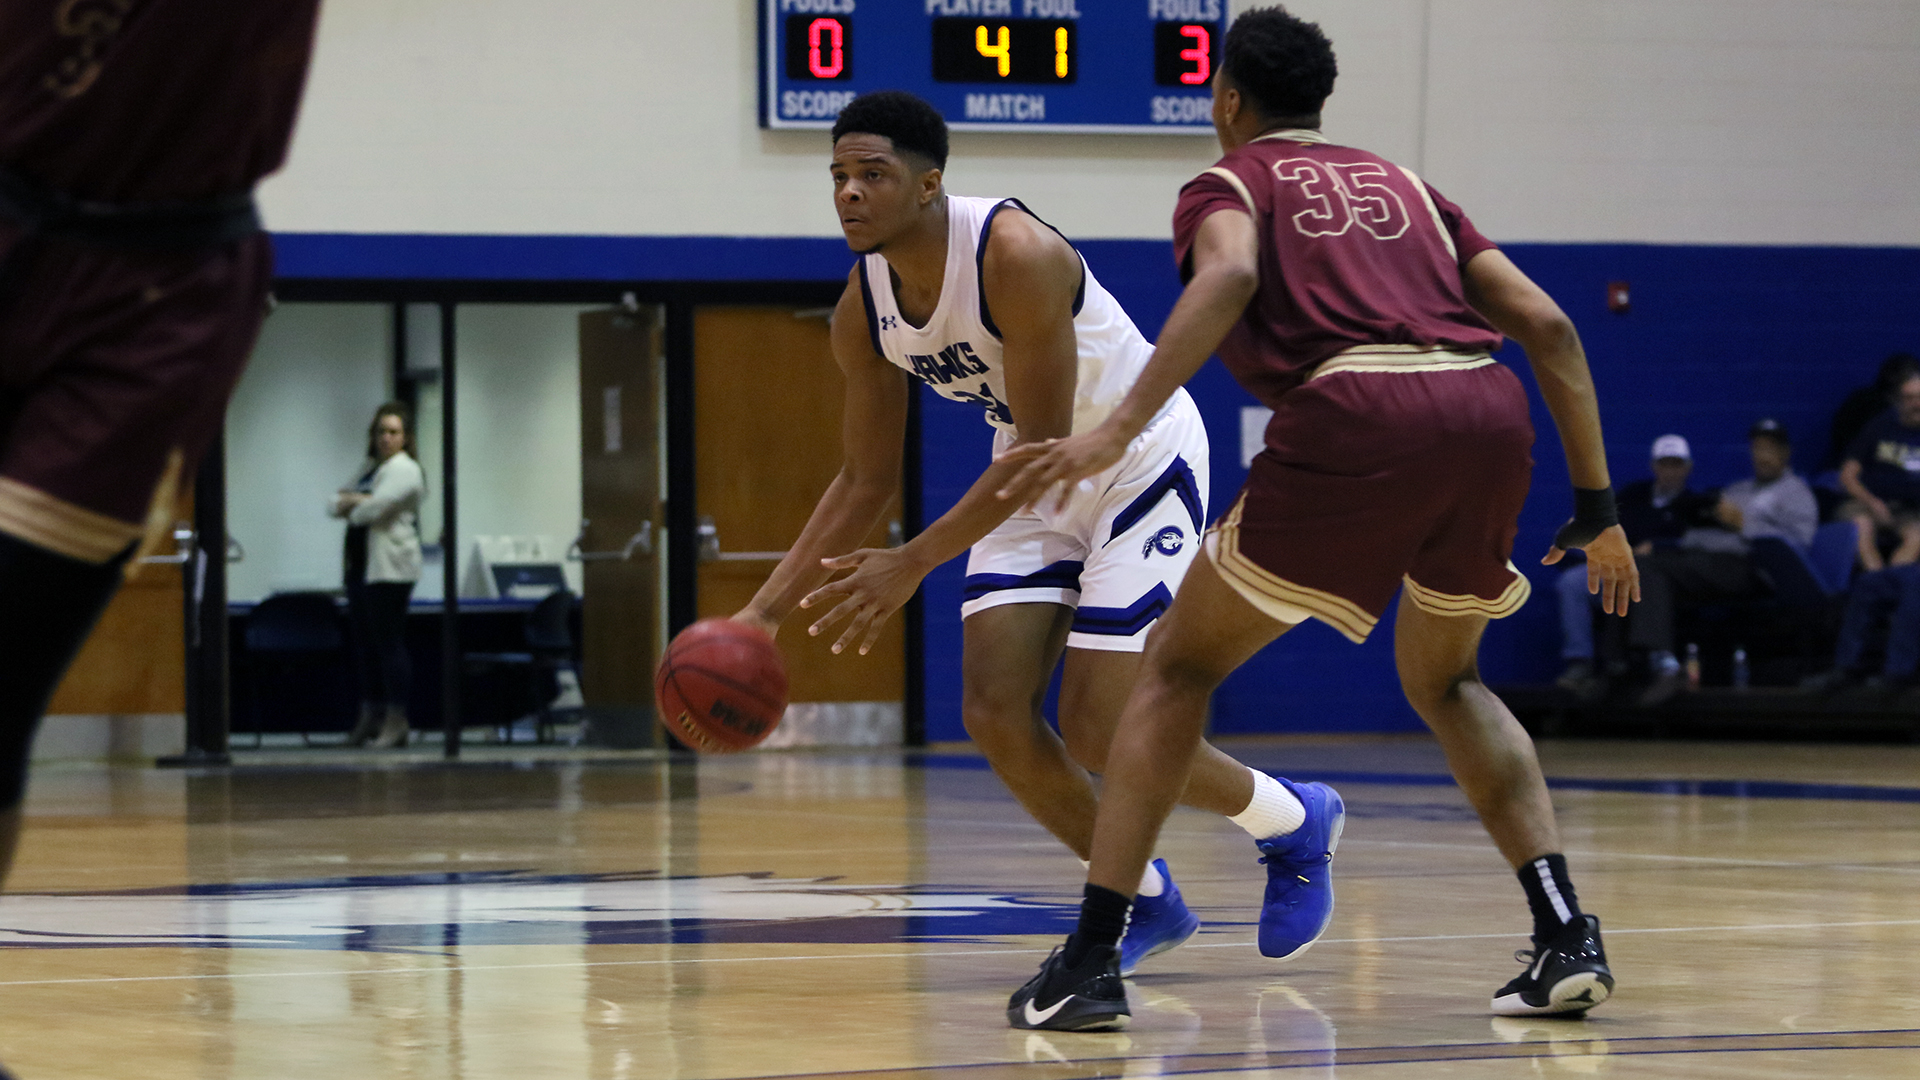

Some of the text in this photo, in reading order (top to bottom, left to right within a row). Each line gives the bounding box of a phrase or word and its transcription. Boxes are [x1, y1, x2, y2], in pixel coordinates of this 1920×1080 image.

[1023, 0, 1082, 18] FOUL
[1149, 0, 1220, 20] FOULS
[808, 18, 843, 78] 0
[975, 25, 1010, 77] 4
[1180, 25, 1210, 84] 3
[965, 93, 1045, 120] MATCH
[1151, 96, 1215, 123] SCOR
[1272, 157, 1411, 240] 35
